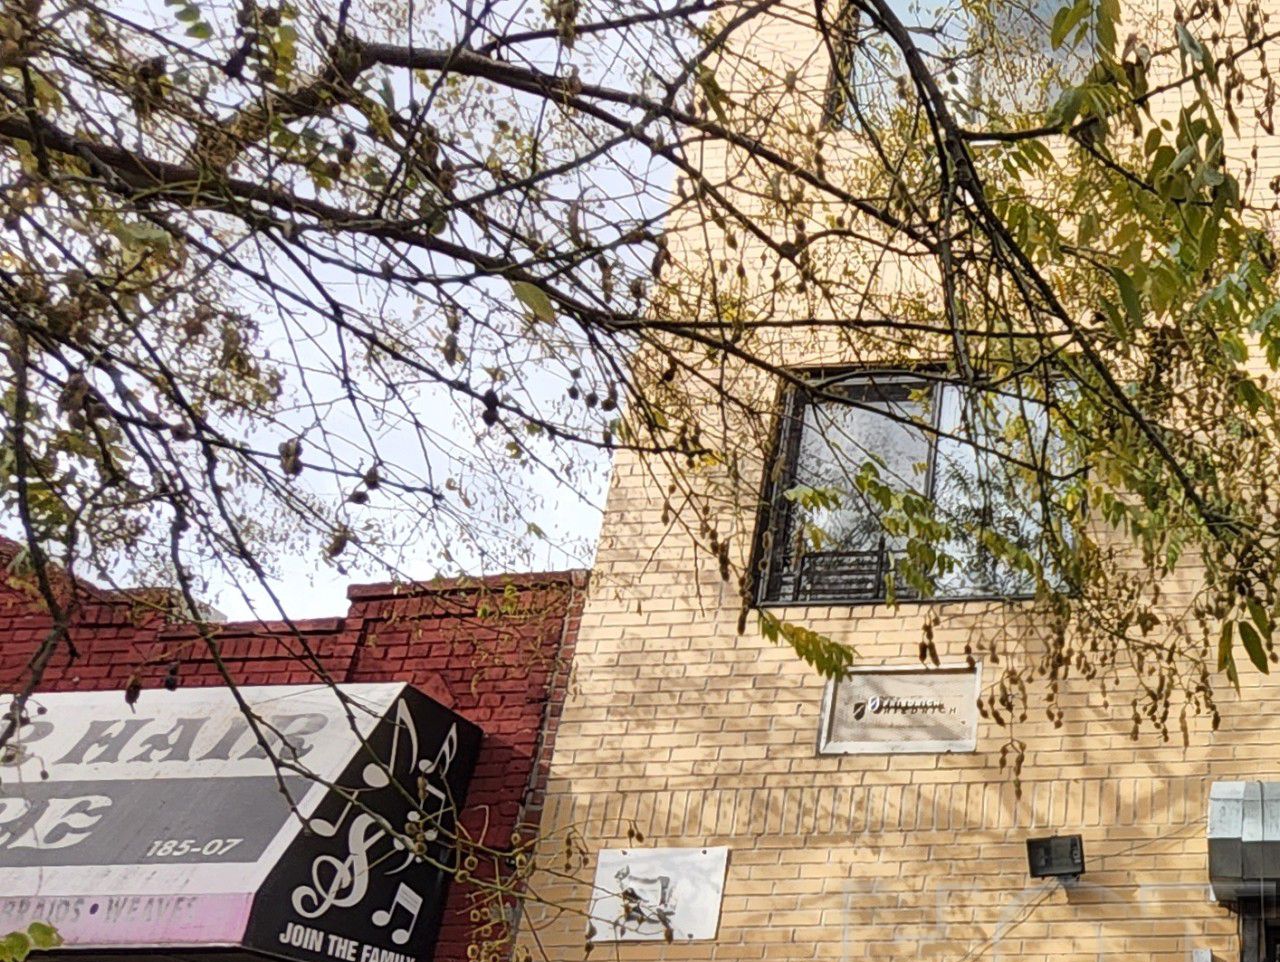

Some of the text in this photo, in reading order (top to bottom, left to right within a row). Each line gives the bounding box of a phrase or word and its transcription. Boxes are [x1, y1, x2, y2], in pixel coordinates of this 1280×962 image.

[52, 712, 329, 766] HAIR
[146, 838, 243, 858] 185-07
[279, 922, 325, 952] JOIN
[327, 934, 359, 962] THE
